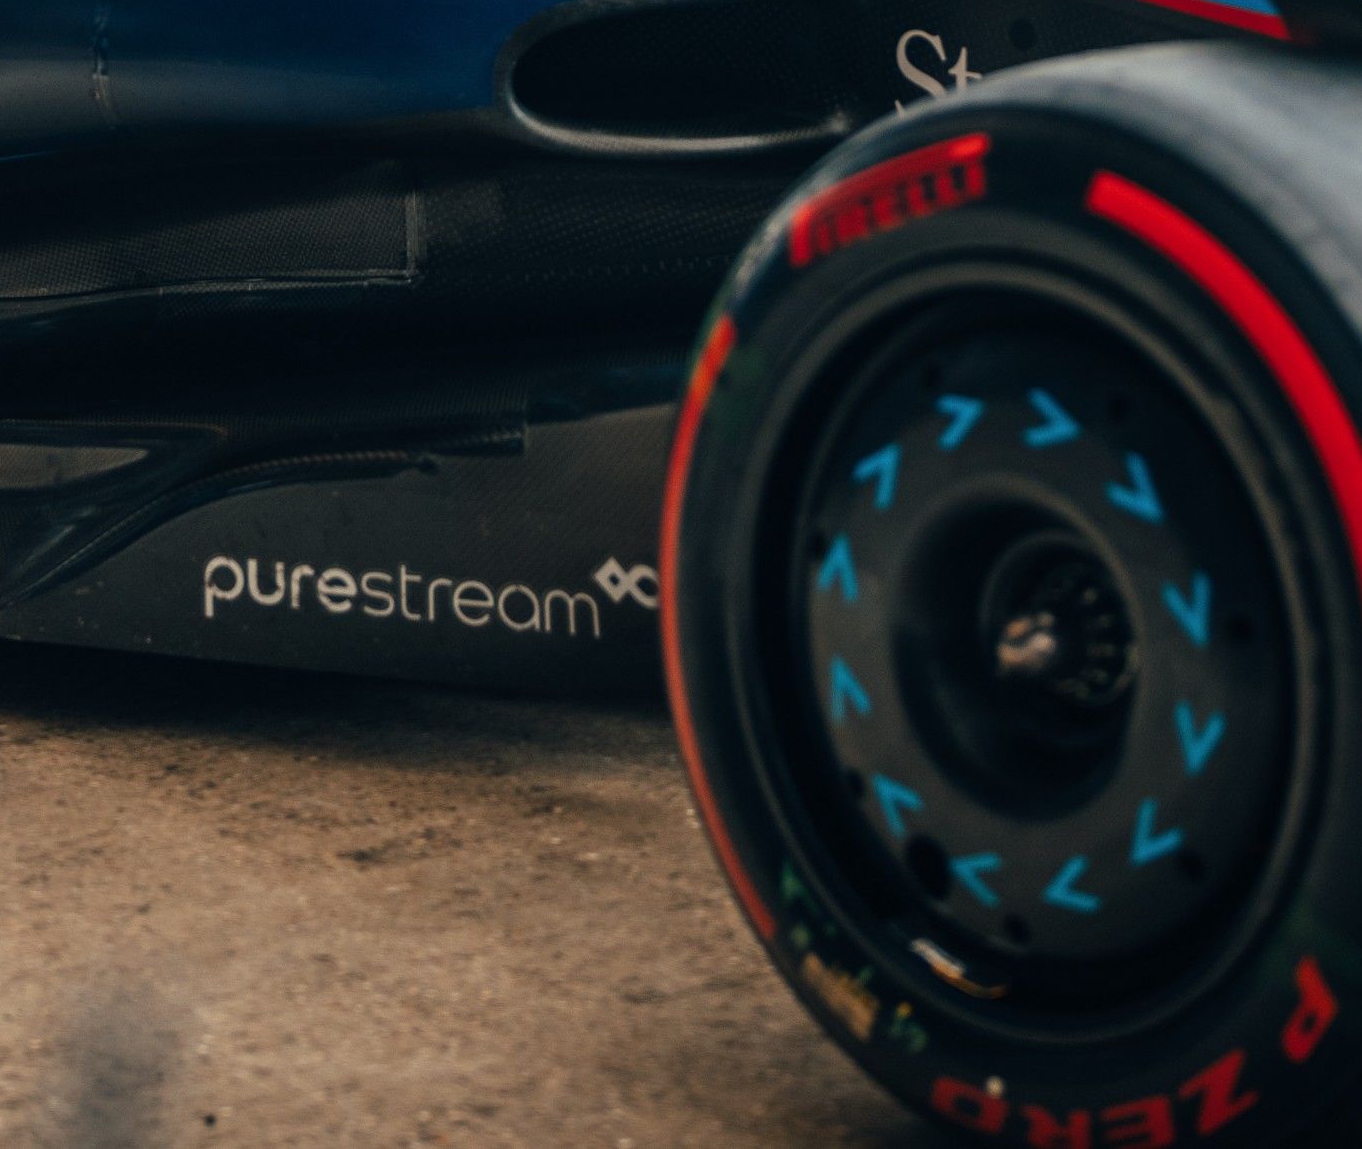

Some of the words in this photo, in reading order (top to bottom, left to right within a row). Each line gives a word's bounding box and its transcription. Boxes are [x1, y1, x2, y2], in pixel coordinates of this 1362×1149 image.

[791, 133, 991, 267] PIRELLI
[204, 554, 600, 639] purestream
[1282, 955, 1337, 1063] P
[930, 1049, 1259, 1149] ZERO
